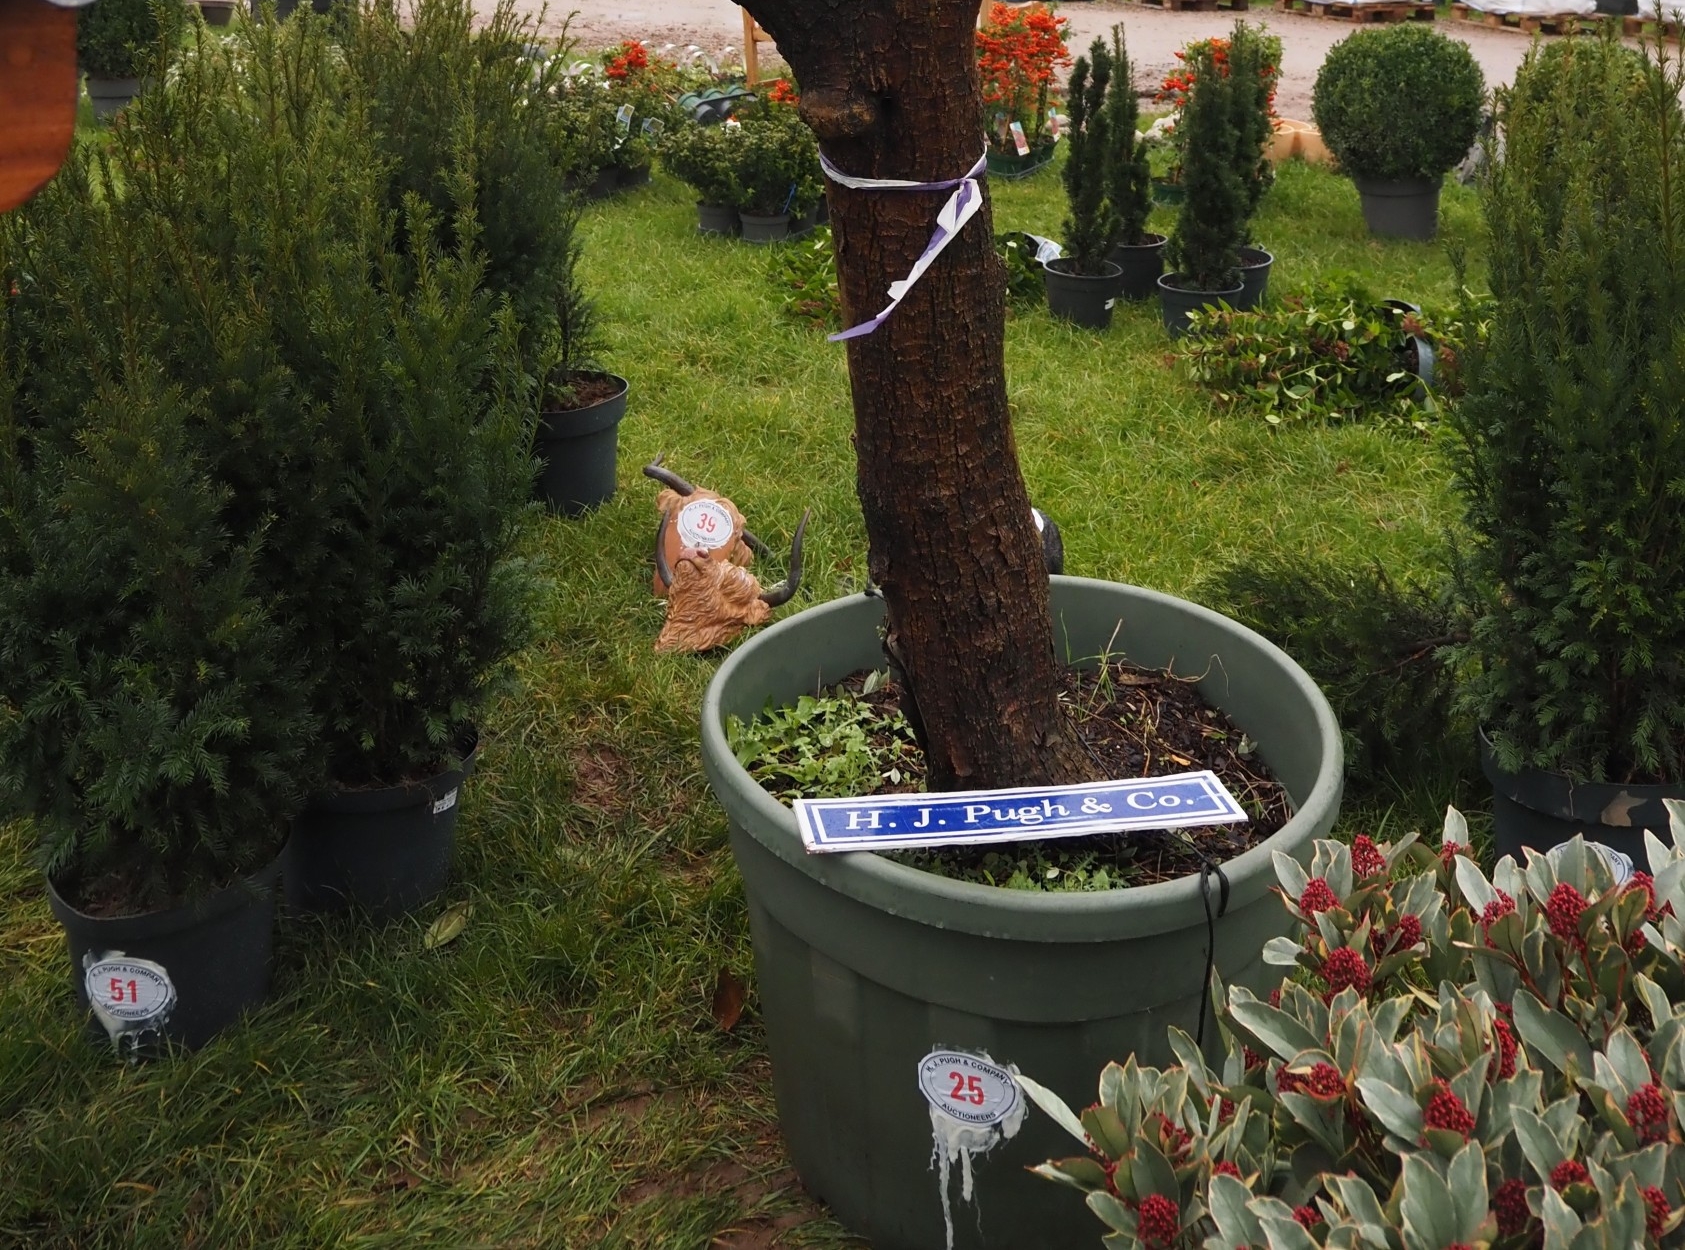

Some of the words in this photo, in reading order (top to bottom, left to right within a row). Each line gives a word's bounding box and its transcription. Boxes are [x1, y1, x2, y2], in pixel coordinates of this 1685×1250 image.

[845, 810, 897, 830] H.
[913, 808, 946, 828] J.
[963, 799, 1070, 825] Pugh
[1080, 797, 1113, 814] &
[1127, 791, 1194, 810] Co.
[110, 978, 138, 1004] 51
[939, 1057, 961, 1065] PUGH
[971, 1062, 1010, 1086] COMPANY
[949, 1071, 985, 1106] 25
[942, 1103, 997, 1121] AUCTIONEERS
